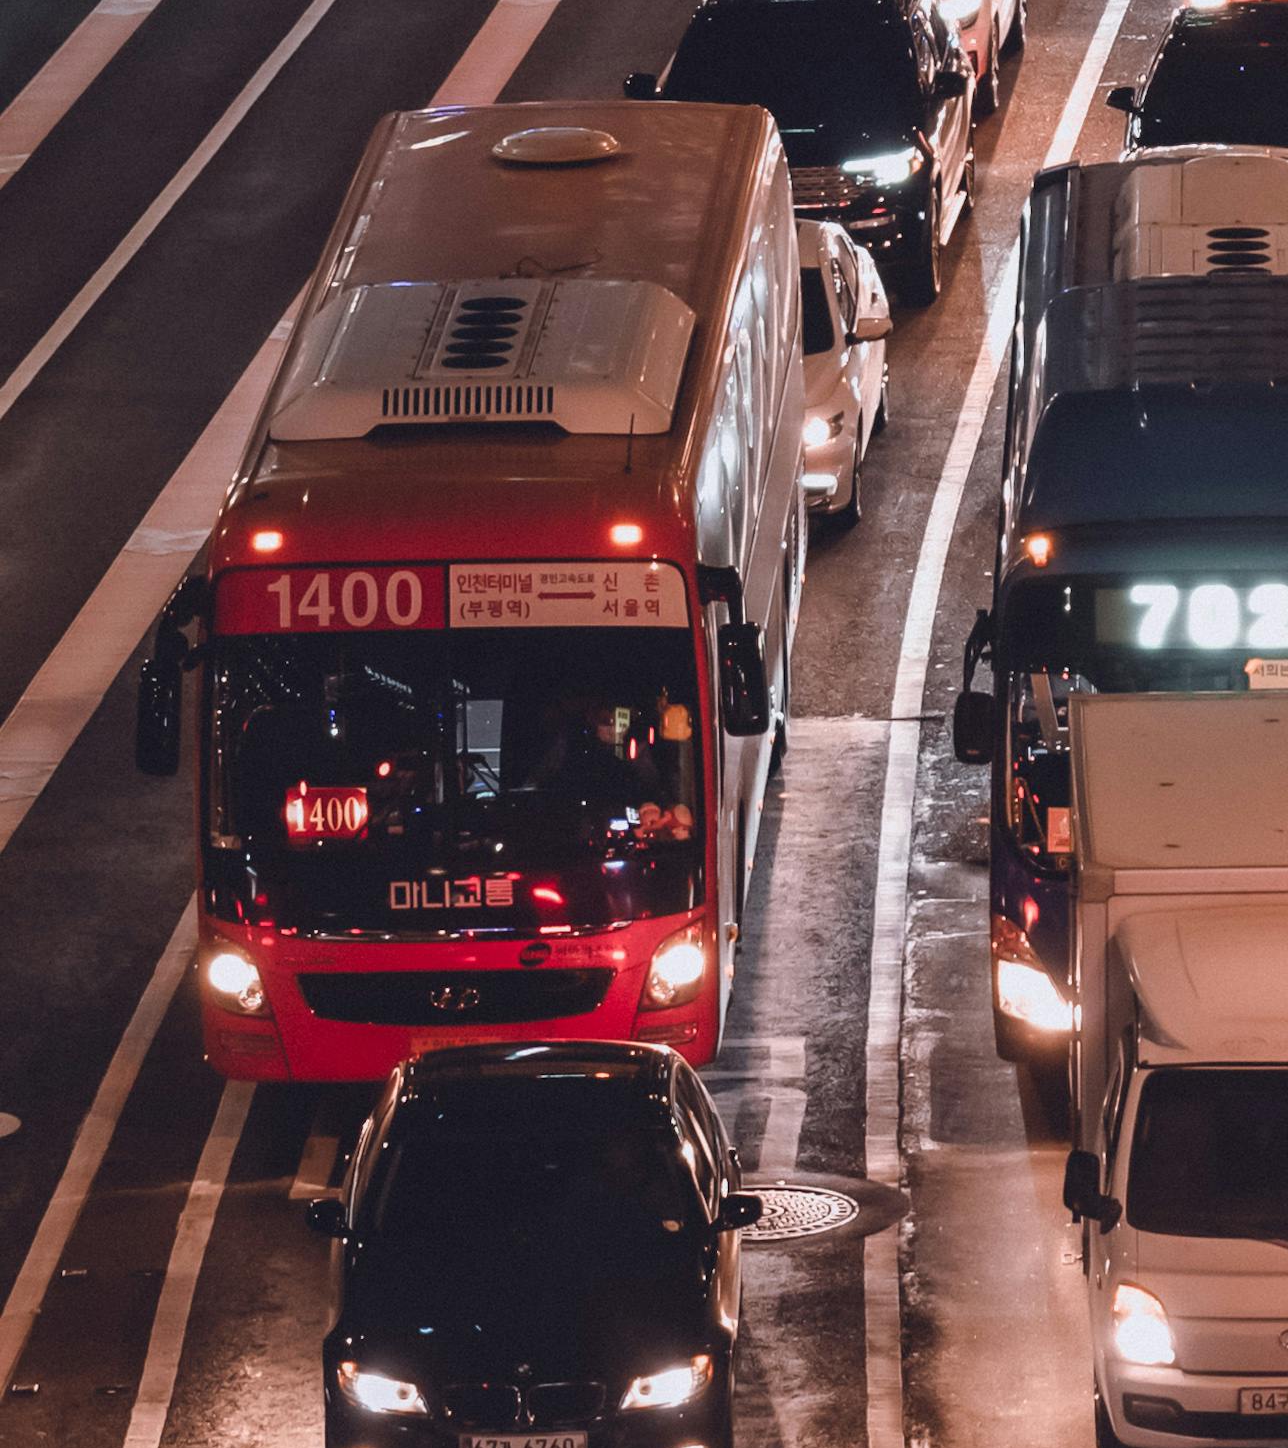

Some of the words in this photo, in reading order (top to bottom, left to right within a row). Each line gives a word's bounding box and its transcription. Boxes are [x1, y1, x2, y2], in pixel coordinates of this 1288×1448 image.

[267, 570, 424, 628] 1400
[457, 573, 533, 594] 인천터미널
[459, 599, 531, 619] (부평역)
[293, 797, 363, 832] 1400
[390, 876, 514, 909] 마니교통
